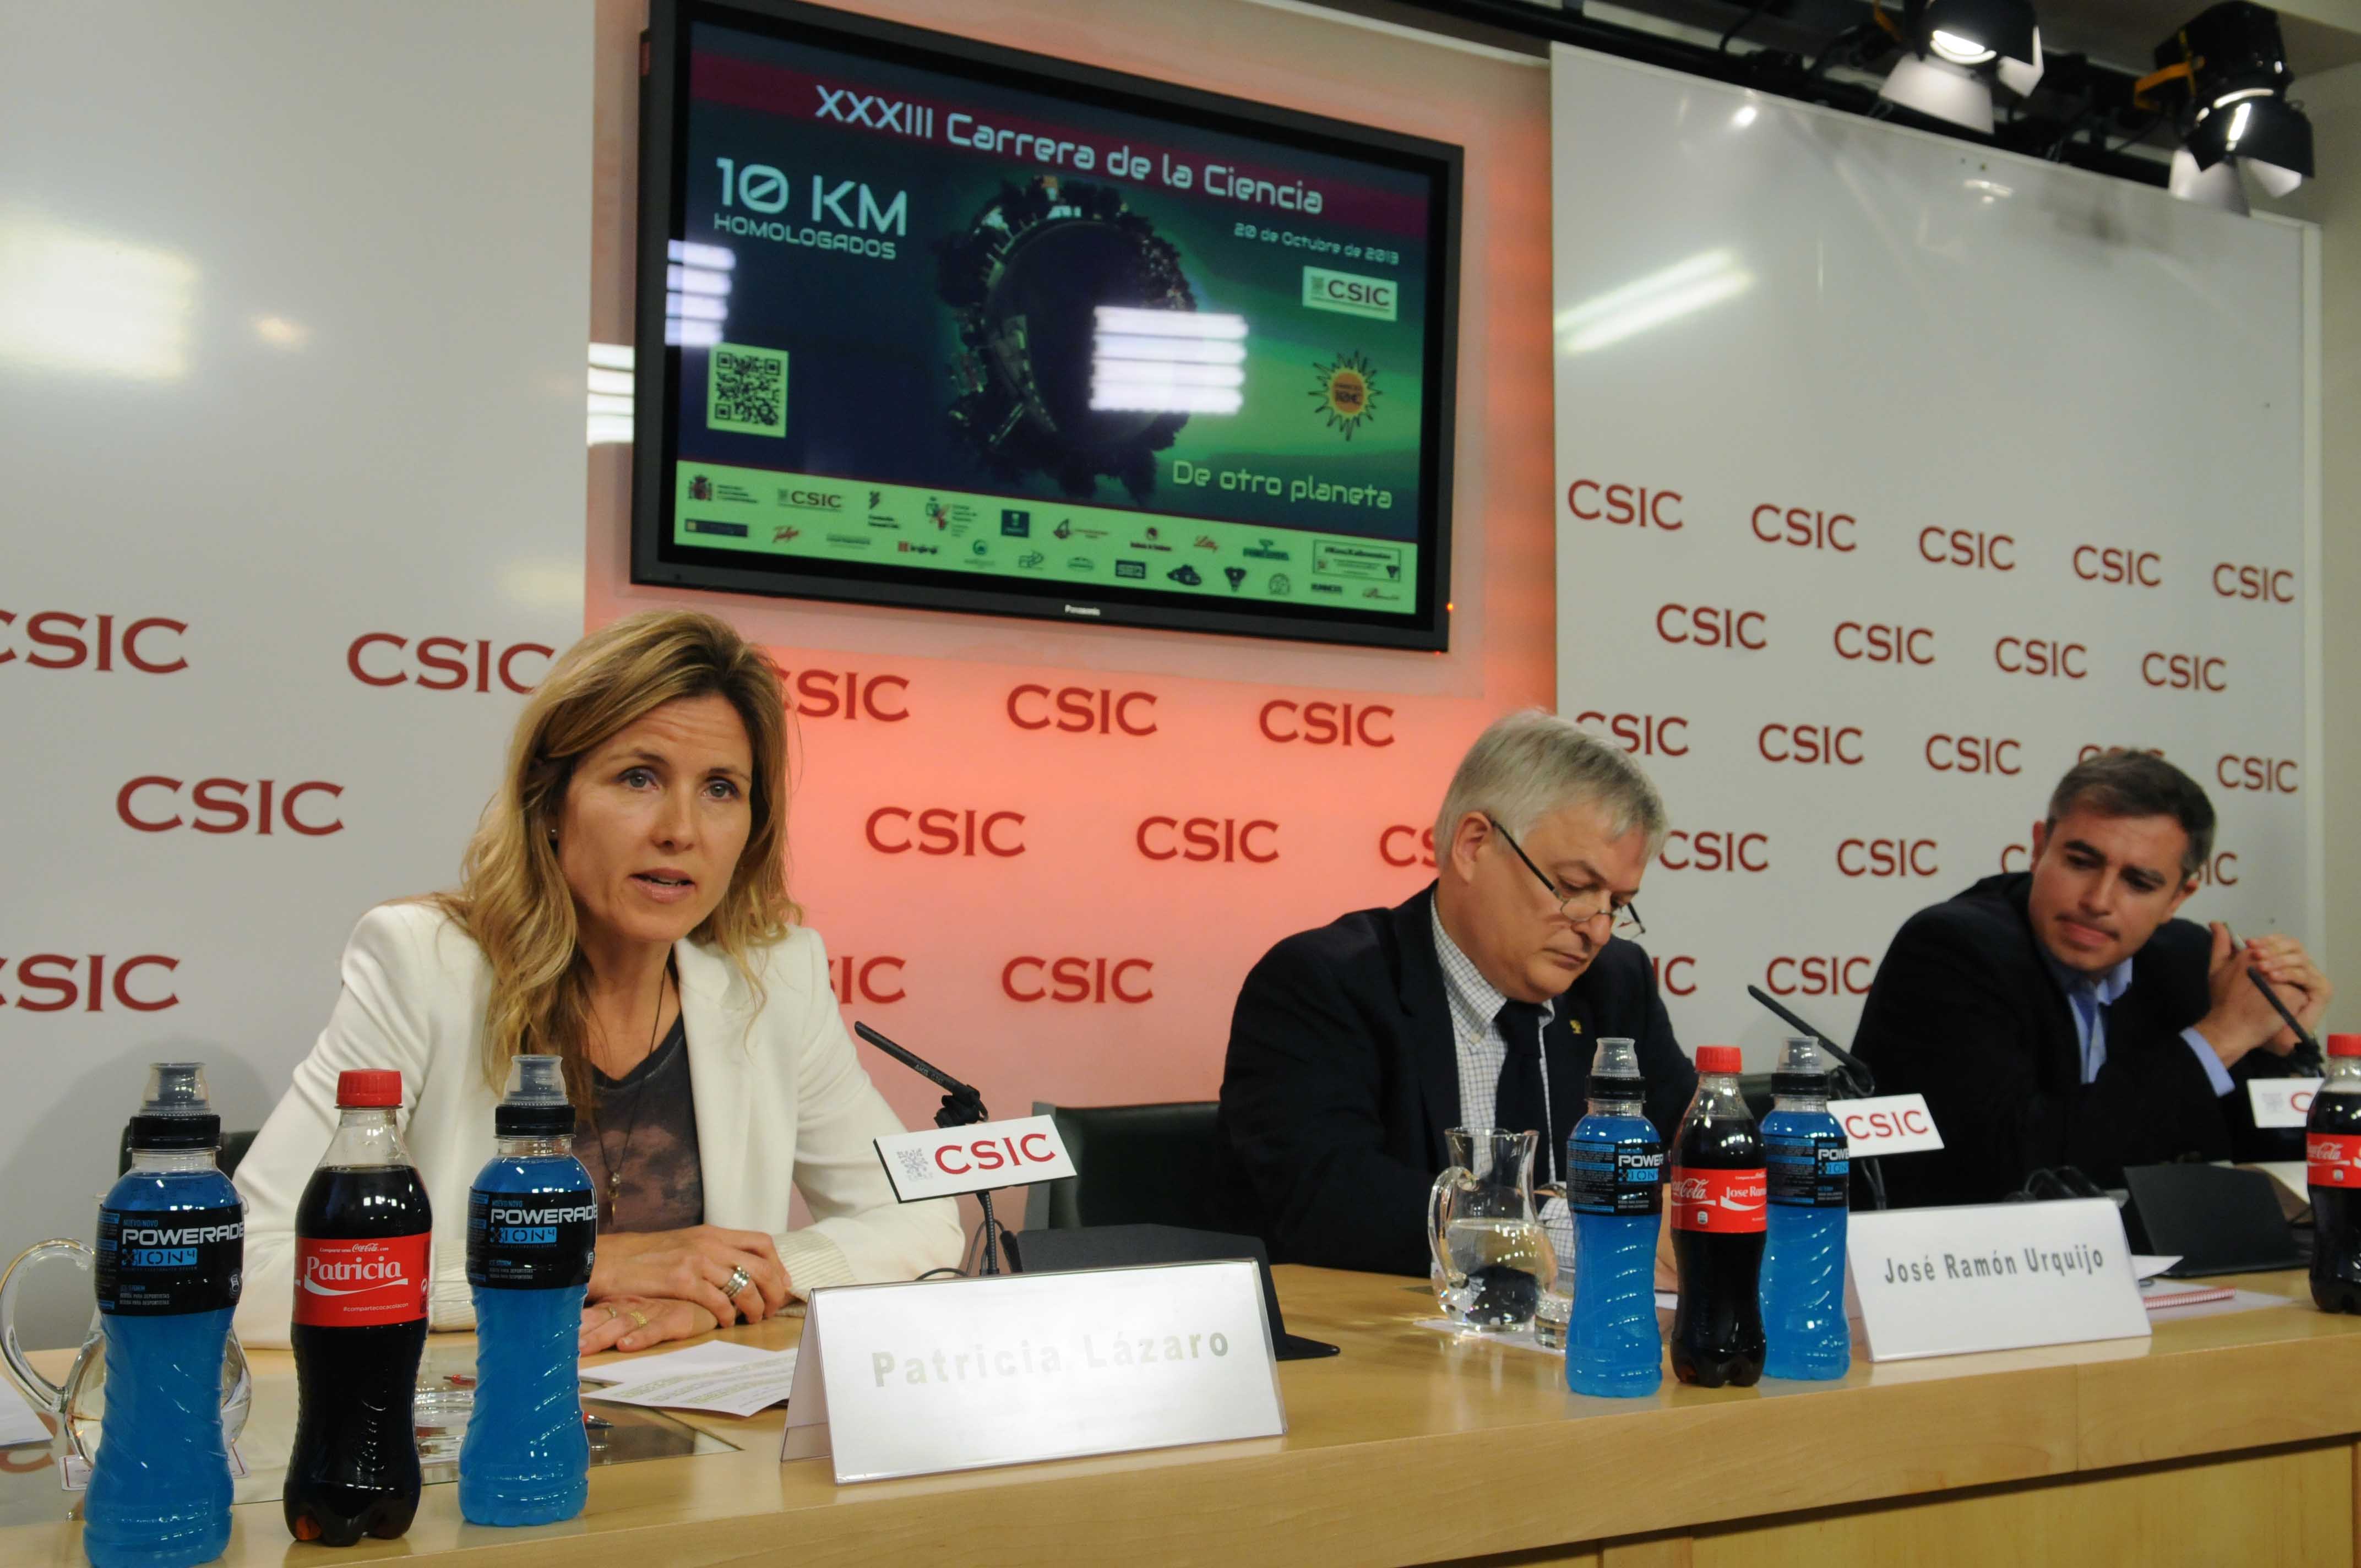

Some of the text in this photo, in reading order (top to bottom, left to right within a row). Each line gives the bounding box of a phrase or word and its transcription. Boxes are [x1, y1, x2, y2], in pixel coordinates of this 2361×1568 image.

[815, 84, 1323, 215] XXXIII Carrera de la Ciencia
[717, 157, 907, 237] 10 KM
[714, 213, 896, 260] HOMOLOGADOS
[1260, 228, 1279, 243] de
[1281, 231, 1341, 254] Octubre
[1343, 244, 1362, 258] de
[1328, 280, 1390, 306] CSIC
[791, 490, 842, 508] CSIC
[1173, 460, 1392, 509] De otro planeta
[1568, 479, 1683, 531] CSIC
[1751, 504, 1856, 552] CSIC
[1920, 527, 2015, 570] CSIC
[2074, 546, 2161, 587] CSIC
[2213, 563, 2294, 602] CSIC
[1656, 604, 1766, 650] CSIC
[1834, 622, 1934, 664] CSIC
[347, 633, 555, 694] CSIC
[1995, 637, 2087, 678] CSIC
[2143, 652, 2226, 692] CSIC
[1007, 684, 1158, 737] CSIC
[1259, 699, 1395, 748] CSIC
[1759, 723, 1863, 765] CSIC
[1925, 734, 2021, 775] CSIC
[2217, 755, 2297, 793] CSIC
[117, 775, 344, 836] CSIC
[866, 807, 1026, 858] CSIC
[1136, 816, 1280, 863] CSIC
[1837, 839, 1938, 878] CSIC
[0, 954, 180, 1012] SIC
[1001, 956, 1154, 1004] CSIC
[1766, 956, 1872, 996] CSIC
[1845, 1110, 1929, 1141] CSIC
[935, 1133, 1056, 1175] CSIC
[122, 1222, 244, 1245] POWERADE
[306, 1256, 402, 1280] Patricia
[1885, 1244, 2103, 1284] José Ramón Urquijo
[343, 1302, 409, 1312] #compartecocacolacon
[872, 1331, 1228, 1387] Patricia Lázaro
